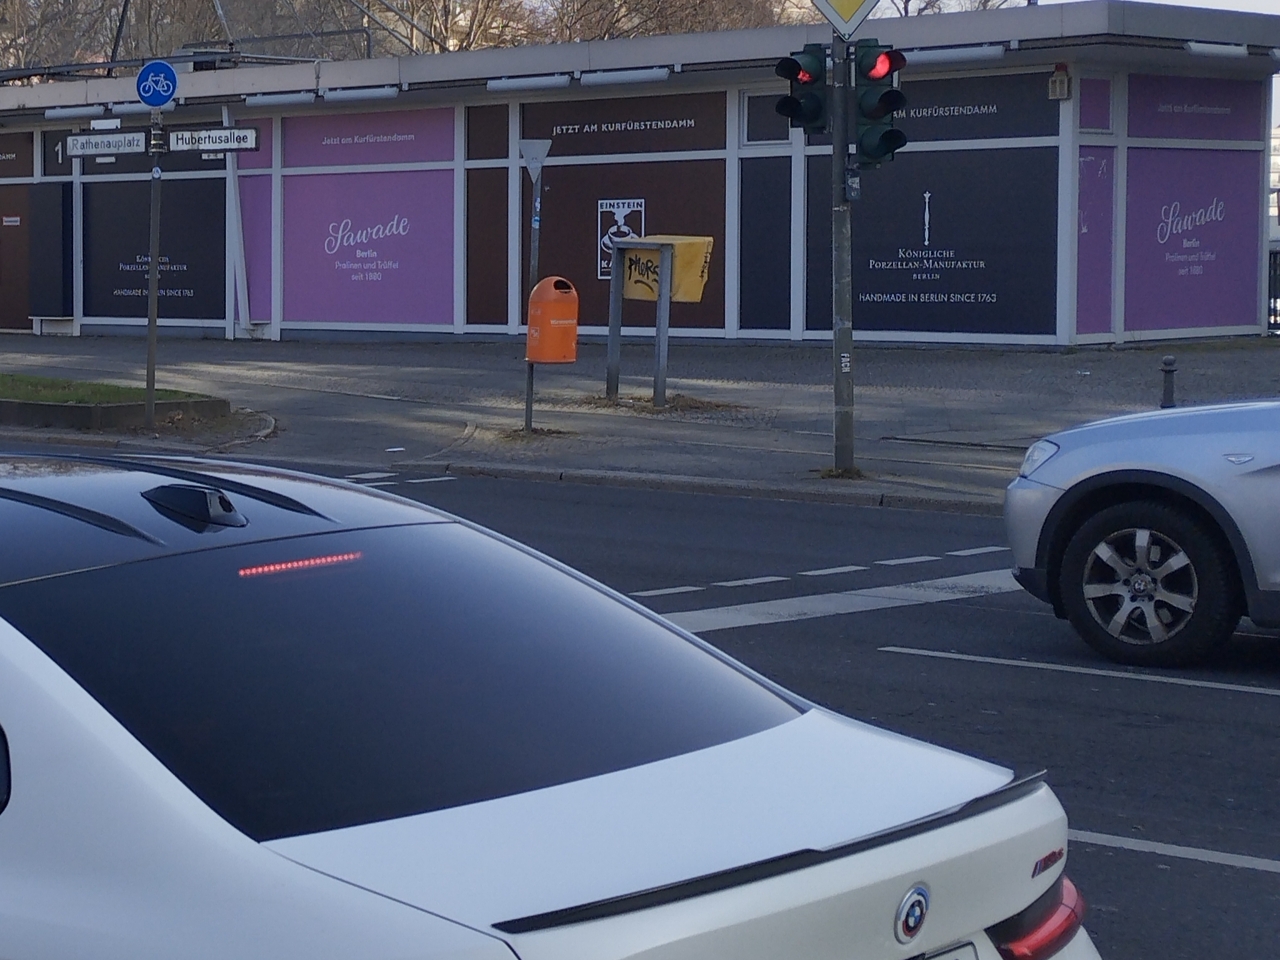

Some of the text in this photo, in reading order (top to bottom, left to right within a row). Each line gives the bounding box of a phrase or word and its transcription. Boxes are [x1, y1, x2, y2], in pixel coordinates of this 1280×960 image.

[910, 104, 997, 118] KURFÜRSTENDAMM
[552, 119, 695, 136] JETZT AM KURFÜRSTENDAMM
[72, 136, 141, 151] Rathenauplatz
[176, 133, 248, 146] Hubertusallee
[322, 136, 340, 145] Jetzt
[354, 133, 415, 143] Kurfürstendamm
[1157, 197, 1225, 244] Sawade
[324, 214, 410, 255] Sawade
[356, 249, 377, 258] Berlin
[898, 249, 955, 258] KÖNIGLICHE
[869, 259, 986, 269] PORZELLAN-MANUFAKTUR
[859, 293, 997, 302] HANDMADE IN BERLIN SINCE 1763
